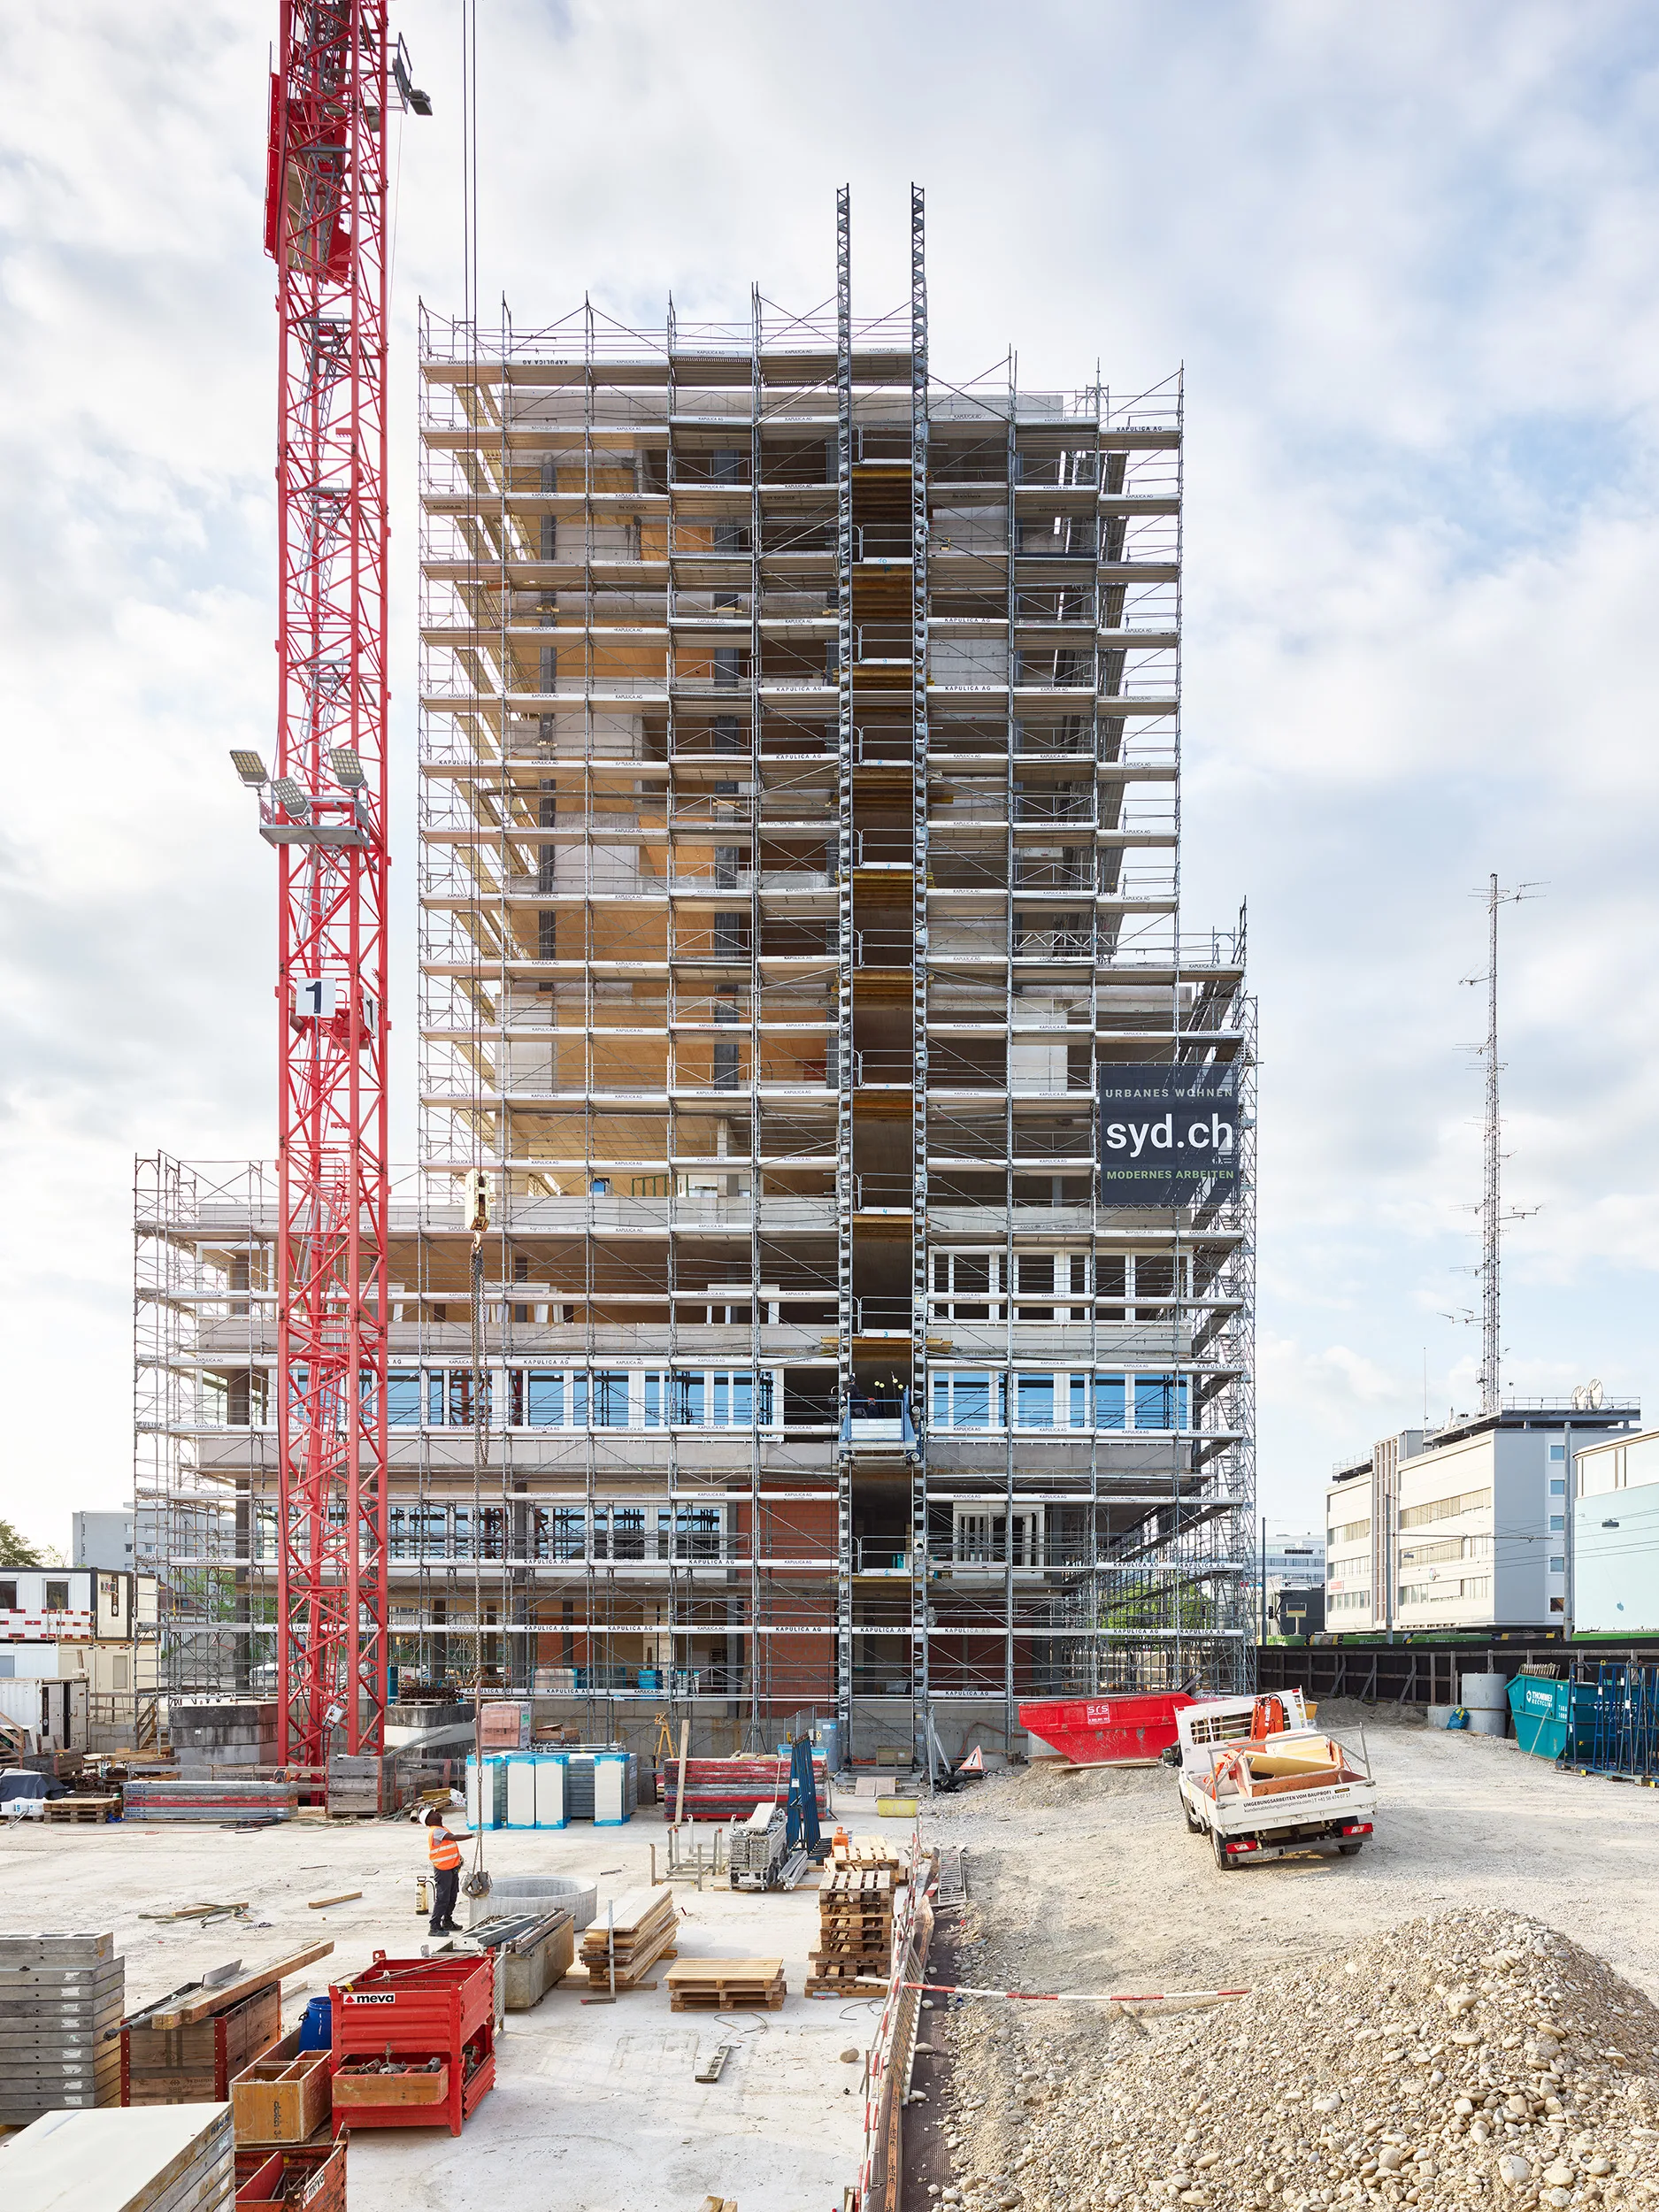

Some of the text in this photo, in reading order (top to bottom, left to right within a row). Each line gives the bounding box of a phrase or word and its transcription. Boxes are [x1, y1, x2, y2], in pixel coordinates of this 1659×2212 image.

[306, 981, 322, 1014] 1
[366, 998, 374, 1031] 1
[1106, 1089, 1233, 1098] URBANES WOHNEN
[1106, 1113, 1233, 1158] syd.ch
[1107, 1170, 1234, 1179] MODERNES ARBEITEN
[1243, 1796, 1296, 1807] UMGEBUNGSARBEITEN
[357, 1995, 394, 2003] meva
